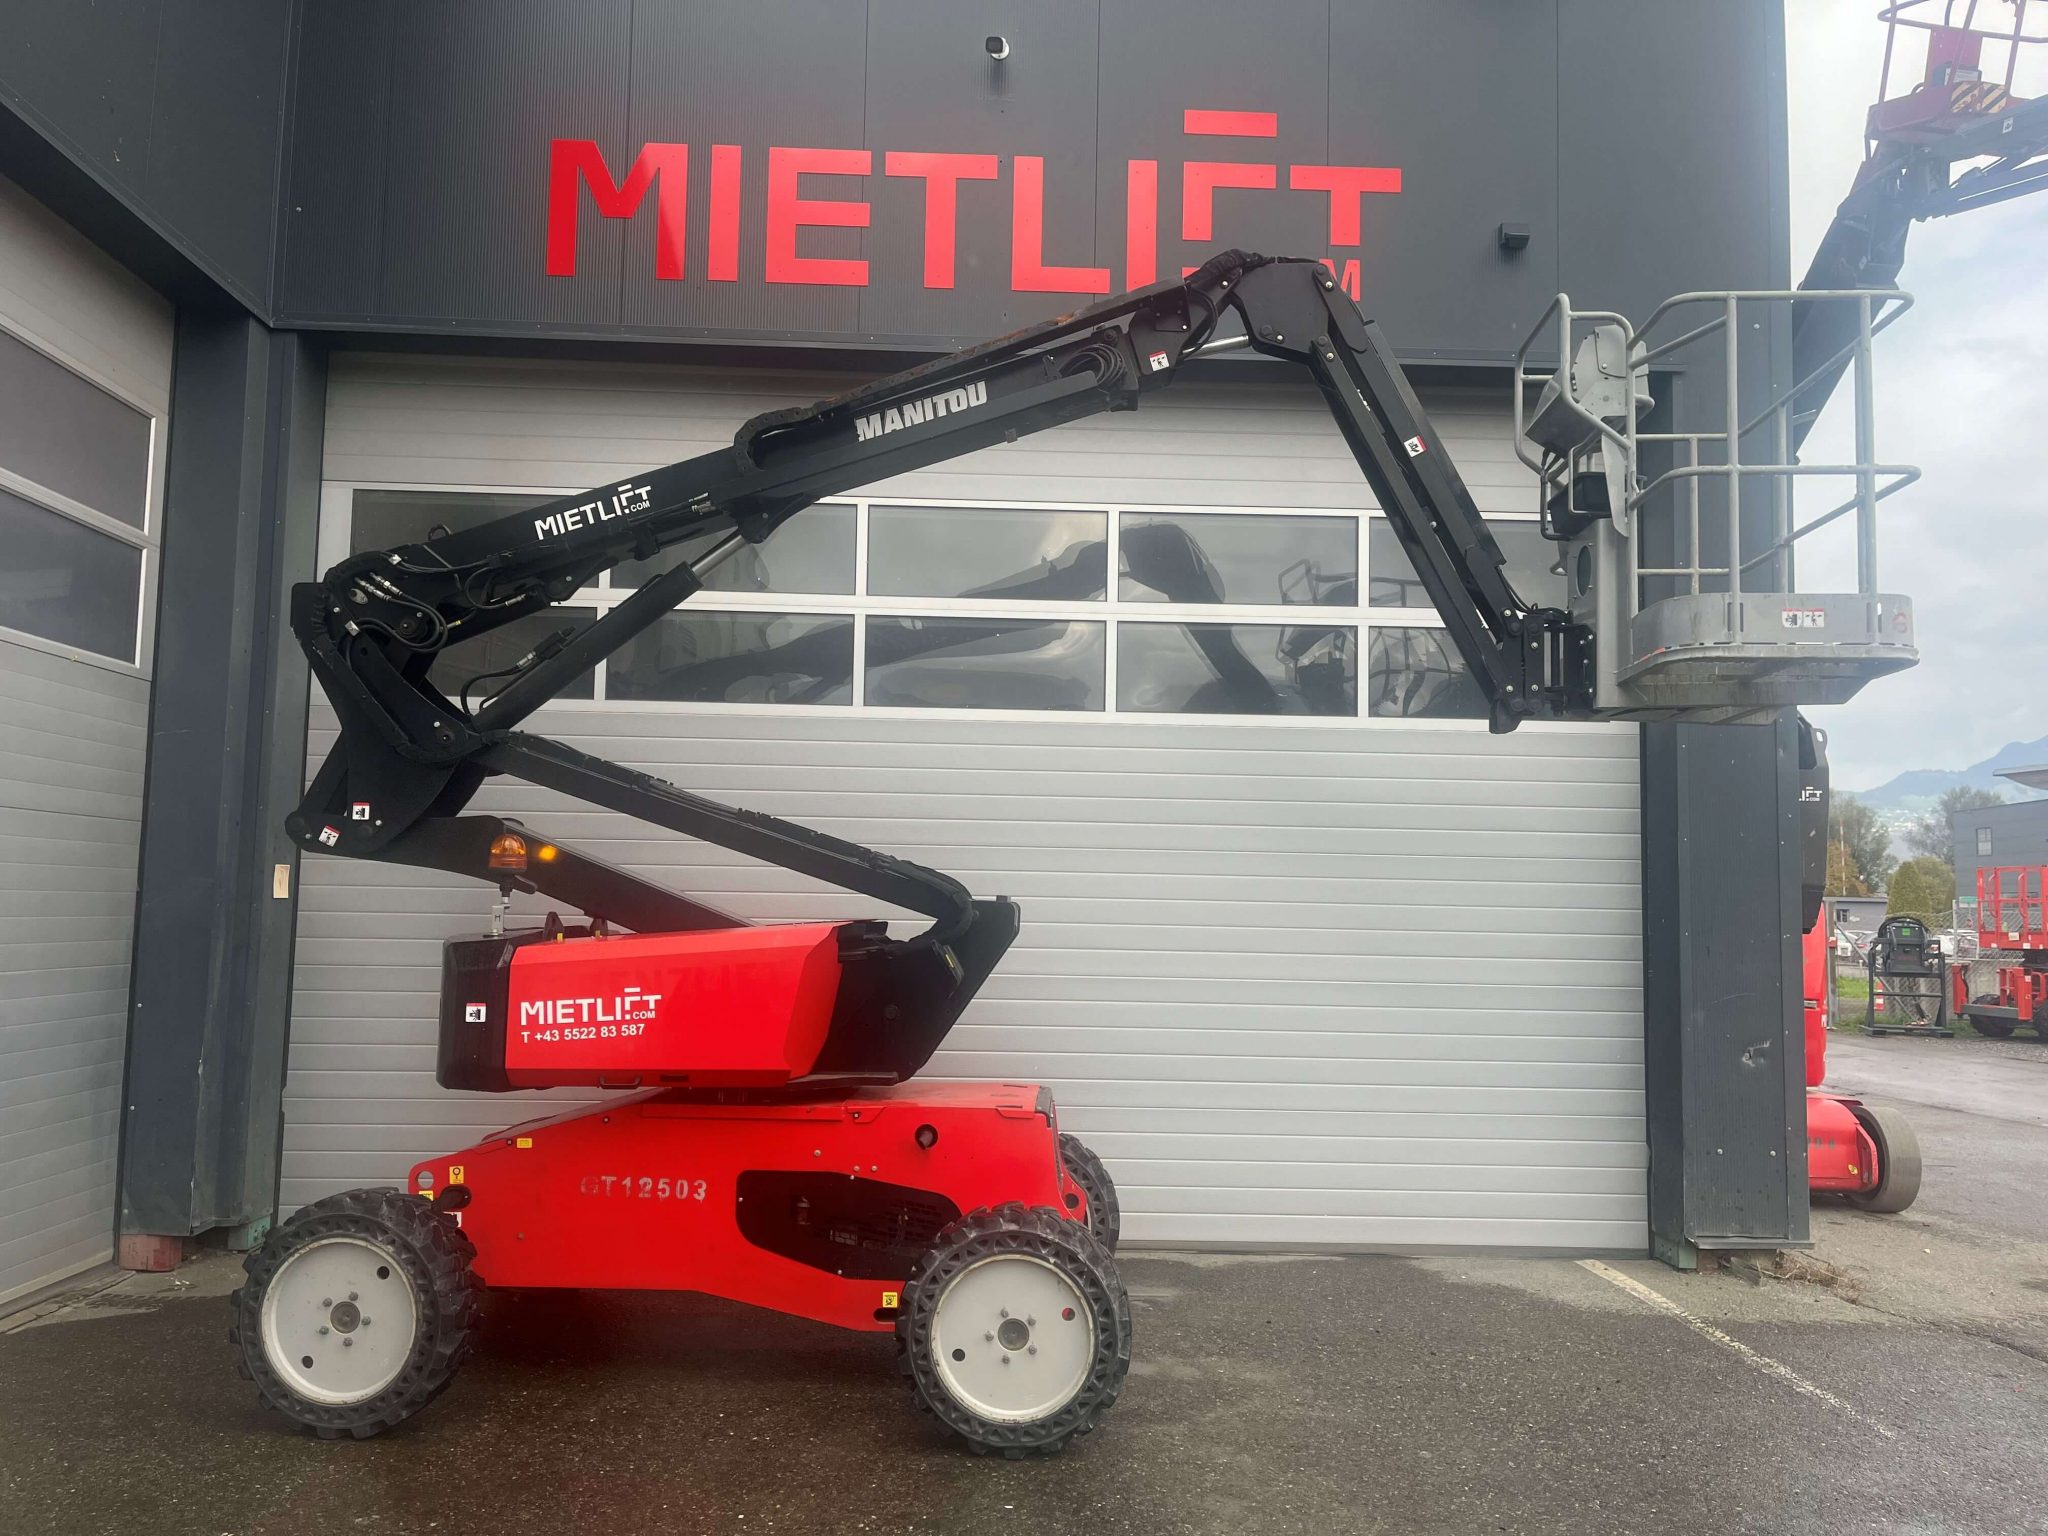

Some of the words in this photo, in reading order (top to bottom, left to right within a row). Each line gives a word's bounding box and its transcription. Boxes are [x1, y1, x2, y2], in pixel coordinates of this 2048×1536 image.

[546, 109, 1402, 293] MIETLIFT
[854, 380, 988, 442] MANITOU
[534, 484, 652, 540] MIETLIFT
[520, 987, 662, 1026] MIETLIFT
[521, 1031, 531, 1044] T
[534, 1029, 560, 1042] +43
[564, 1027, 597, 1041] 5522
[600, 1025, 618, 1038] 83
[621, 1023, 645, 1037] 587
